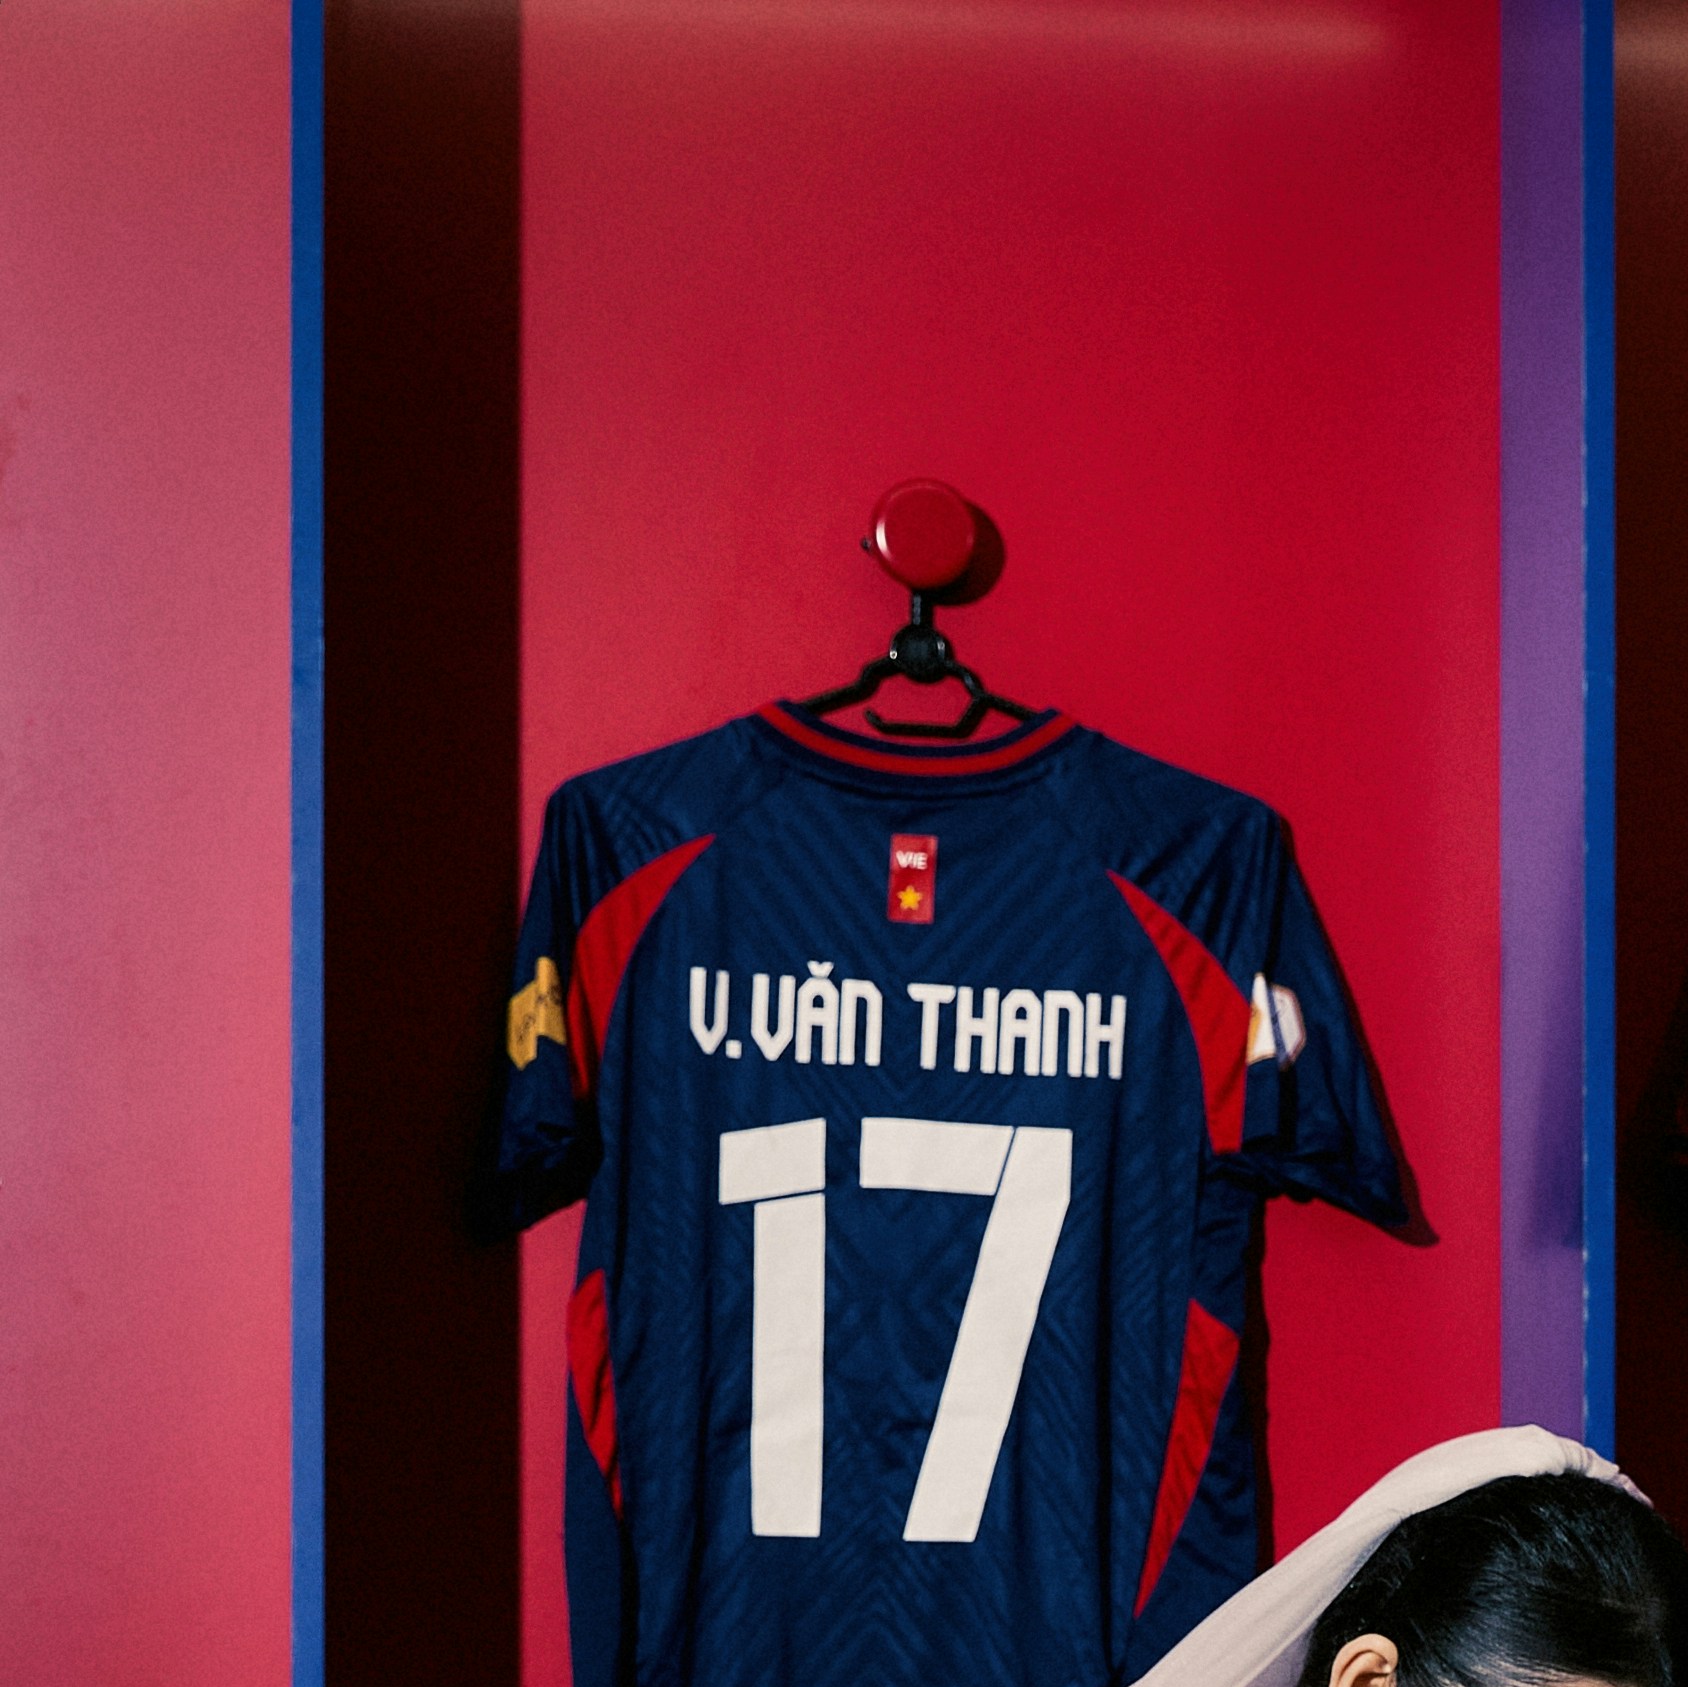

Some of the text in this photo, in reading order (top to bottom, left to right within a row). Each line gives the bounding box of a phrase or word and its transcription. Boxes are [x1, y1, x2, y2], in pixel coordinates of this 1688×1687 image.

[688, 960, 1127, 1080] V.VĂN THANH
[718, 1116, 1074, 1543] 17
